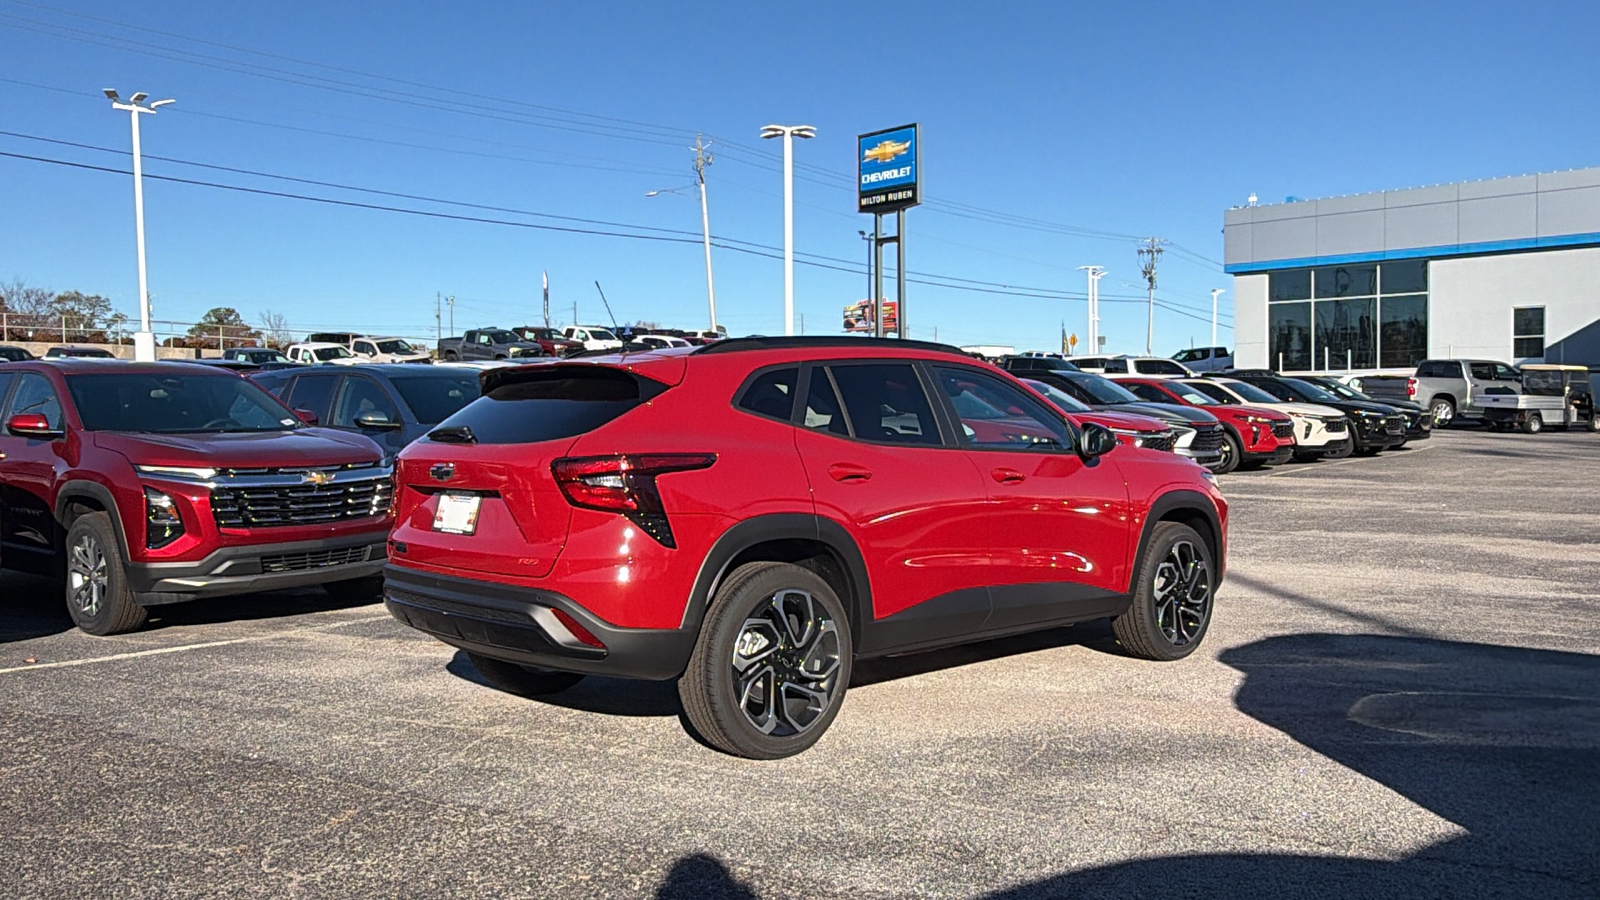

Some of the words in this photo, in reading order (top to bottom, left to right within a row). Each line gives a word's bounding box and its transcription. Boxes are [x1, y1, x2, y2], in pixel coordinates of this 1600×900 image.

[862, 166, 912, 184] CHEVROLET
[861, 195, 886, 206] MILTON
[887, 190, 913, 202] RUBEN
